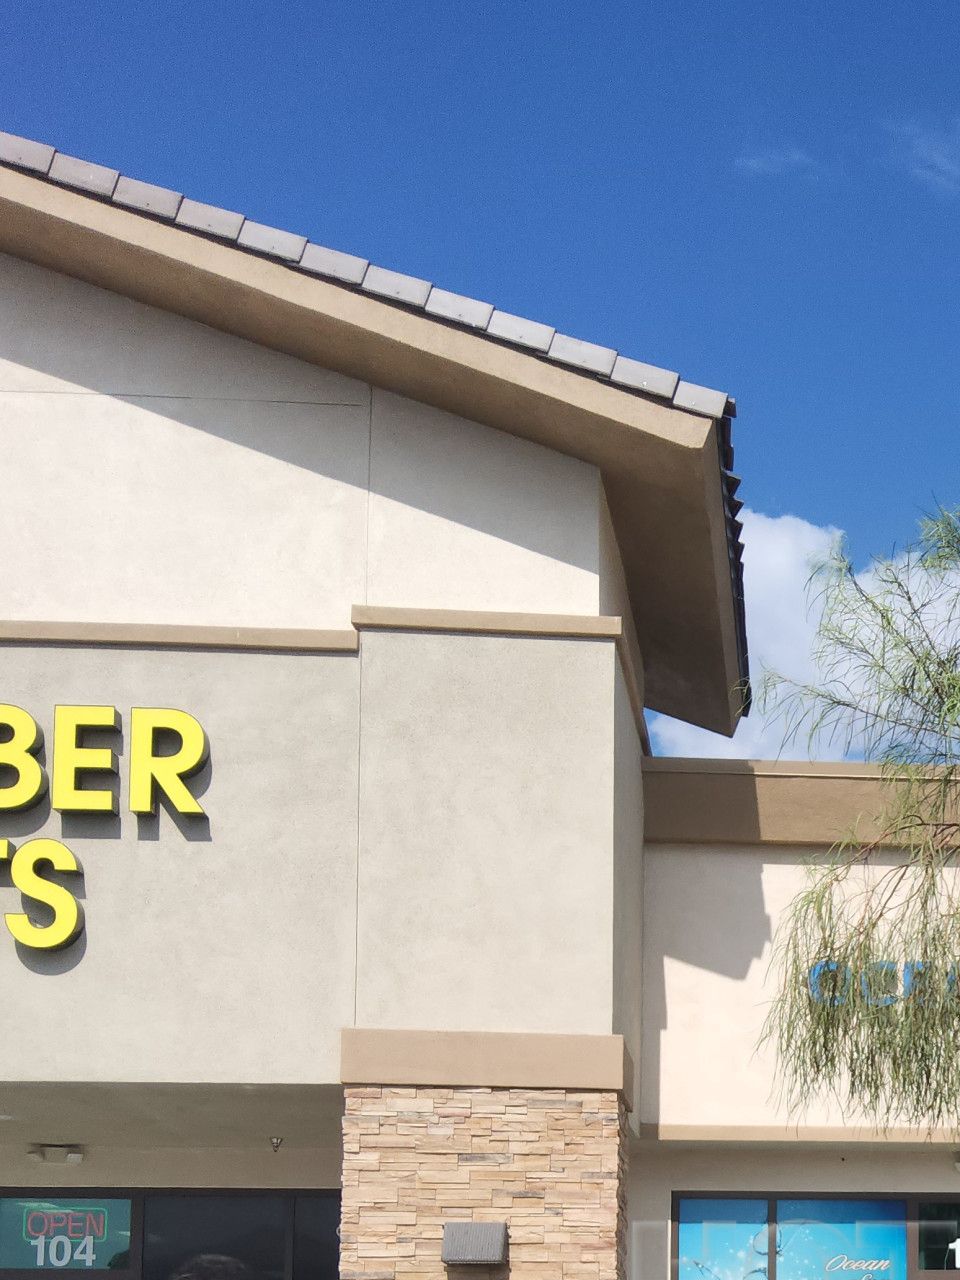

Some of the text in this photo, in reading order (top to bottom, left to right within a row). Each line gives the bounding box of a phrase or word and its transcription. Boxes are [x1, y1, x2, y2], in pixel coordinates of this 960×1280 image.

[0, 703, 205, 813] BER
[0, 838, 79, 948] S
[27, 1212, 104, 1237] OPEN
[31, 1235, 97, 1267] 104
[825, 1254, 890, 1272] Ocean
